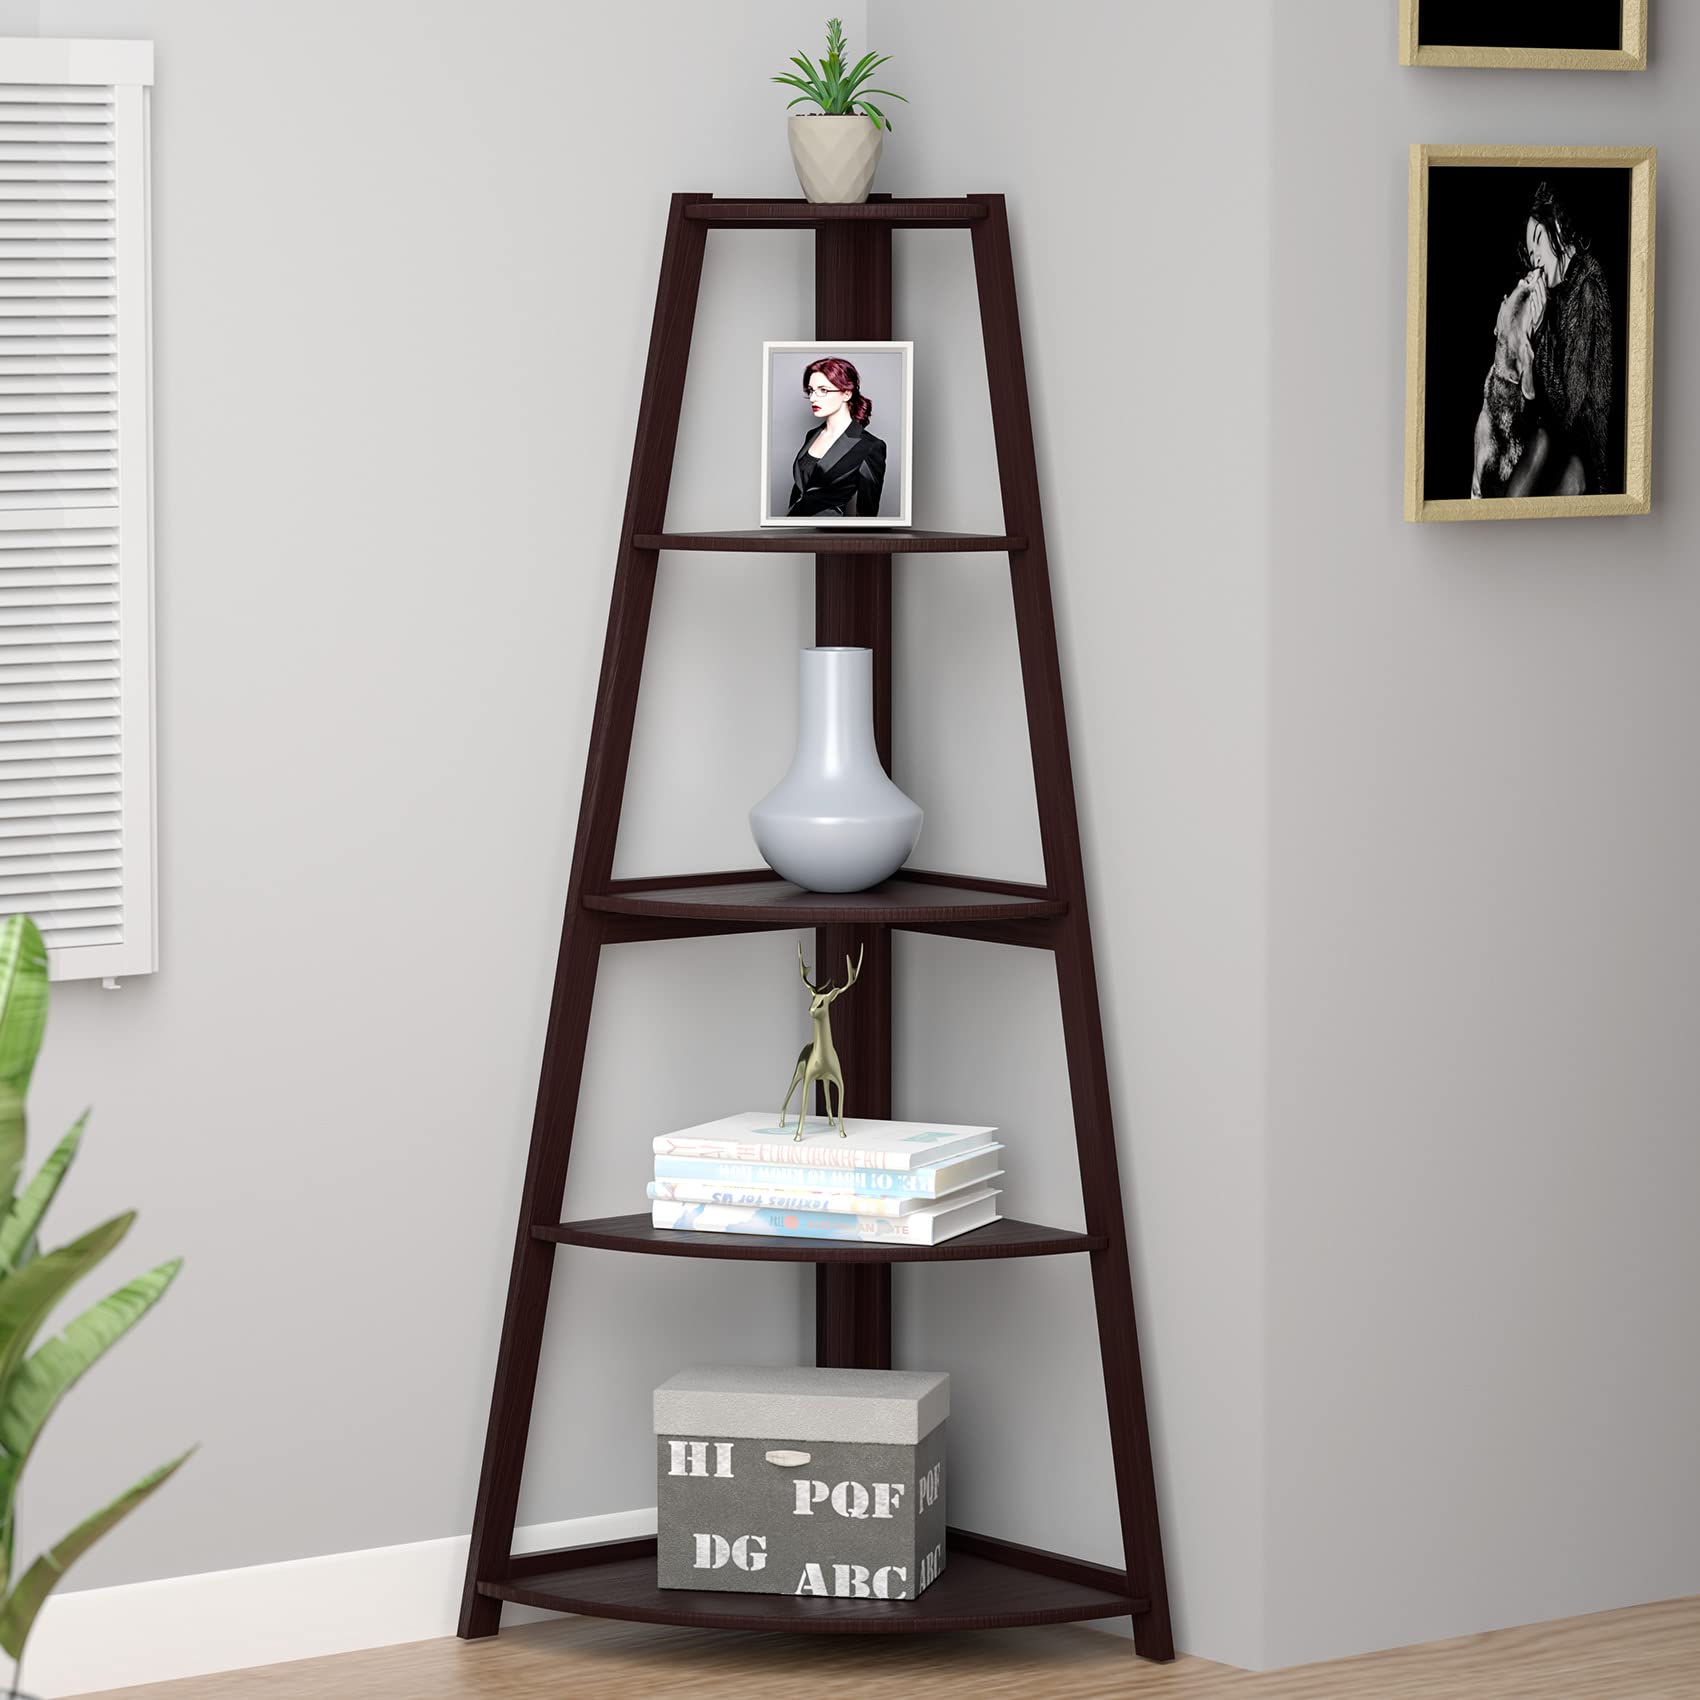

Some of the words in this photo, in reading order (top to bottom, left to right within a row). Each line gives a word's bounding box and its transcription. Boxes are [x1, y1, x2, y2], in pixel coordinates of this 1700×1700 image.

[667, 1440, 735, 1478] HI
[792, 1479, 905, 1520] PQF
[918, 1462, 941, 1514] PQF
[693, 1533, 768, 1571] DG
[919, 1544, 941, 1594] ABC
[794, 1562, 907, 1600] ABC
